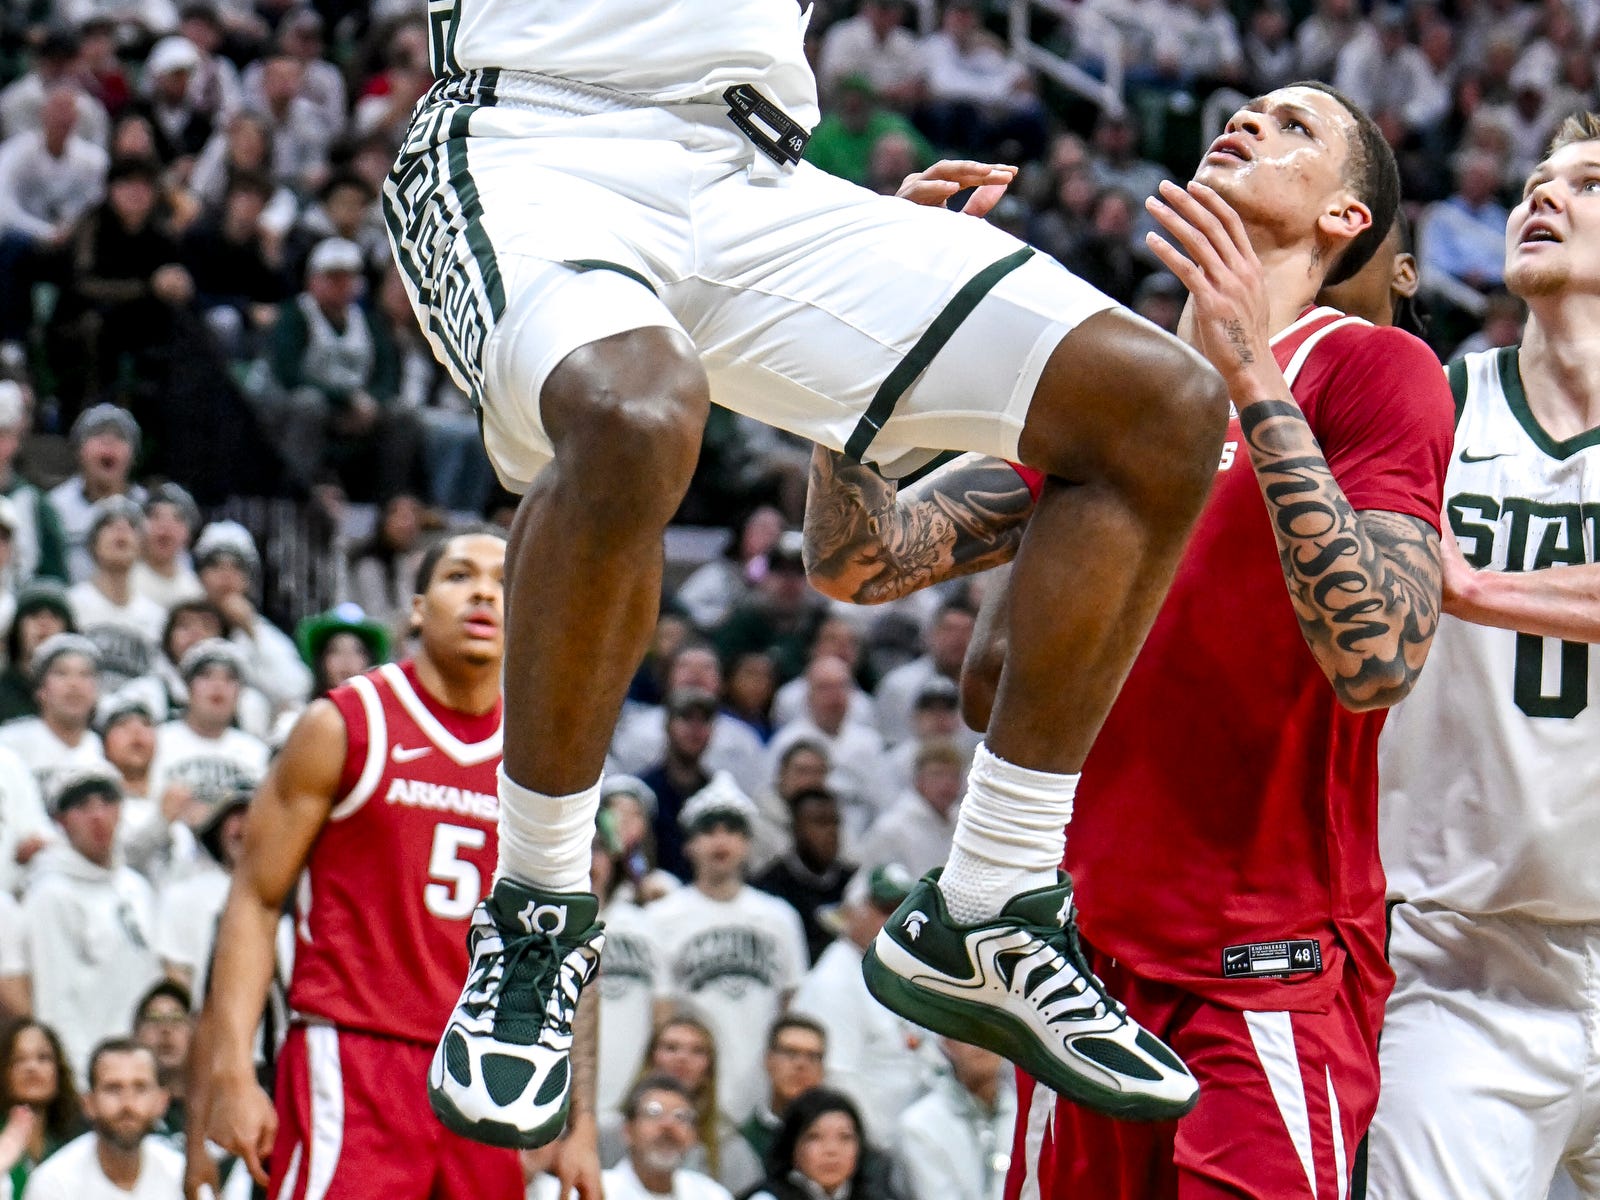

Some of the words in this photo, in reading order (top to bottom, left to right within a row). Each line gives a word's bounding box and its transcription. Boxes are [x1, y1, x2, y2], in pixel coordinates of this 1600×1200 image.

[788, 135, 803, 152] 48
[424, 822, 486, 919] 5
[1294, 948, 1311, 961] 48
